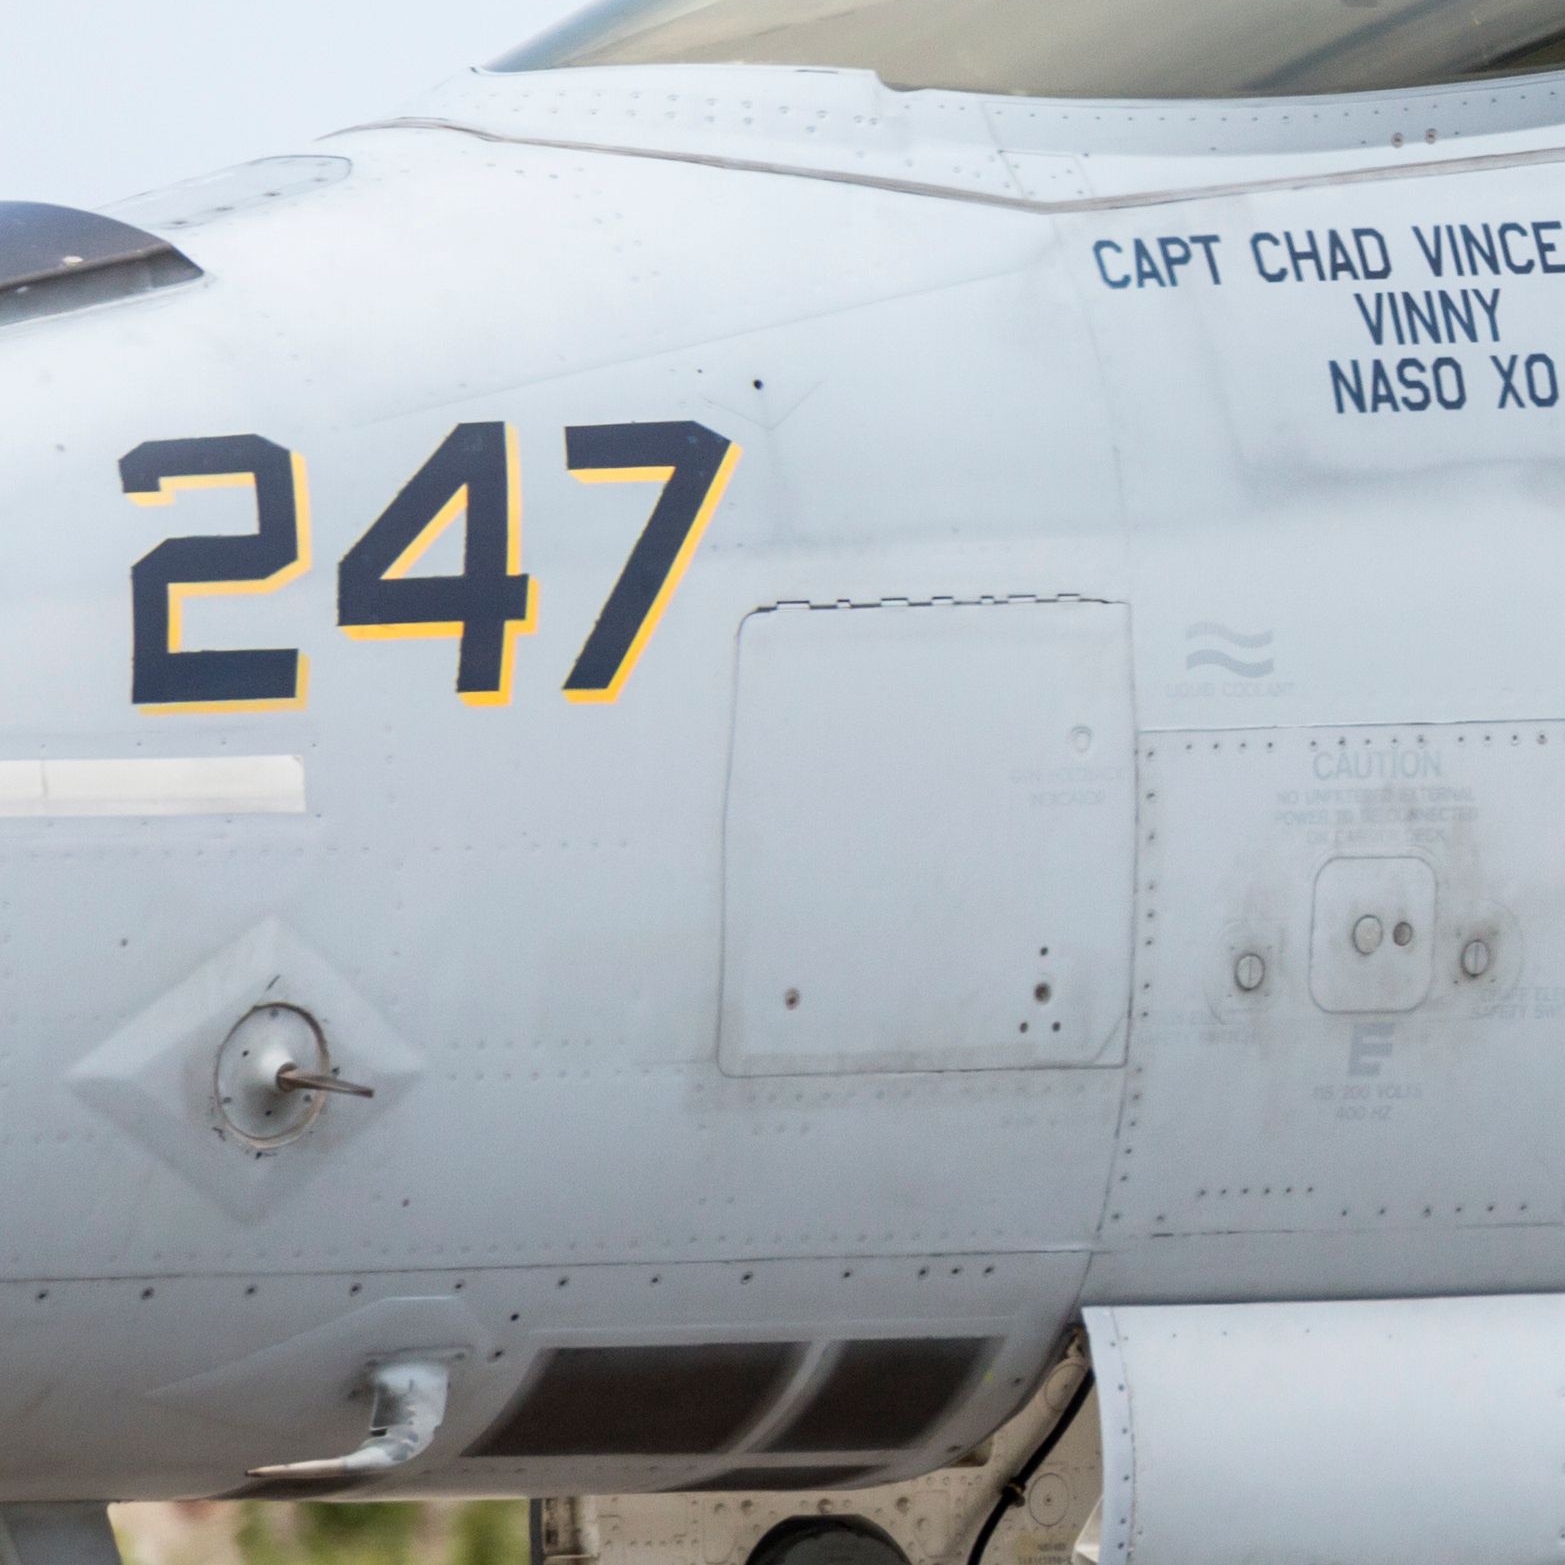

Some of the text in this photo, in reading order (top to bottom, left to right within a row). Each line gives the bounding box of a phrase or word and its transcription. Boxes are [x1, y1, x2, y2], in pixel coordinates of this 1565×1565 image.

[1093, 234, 1223, 290] CAPT
[1249, 227, 1392, 283] CHAD
[1354, 288, 1502, 346] VINNY
[1328, 352, 1560, 414] NASO XO
[118, 420, 743, 716] 247
[1312, 749, 1443, 781] CAUTION
